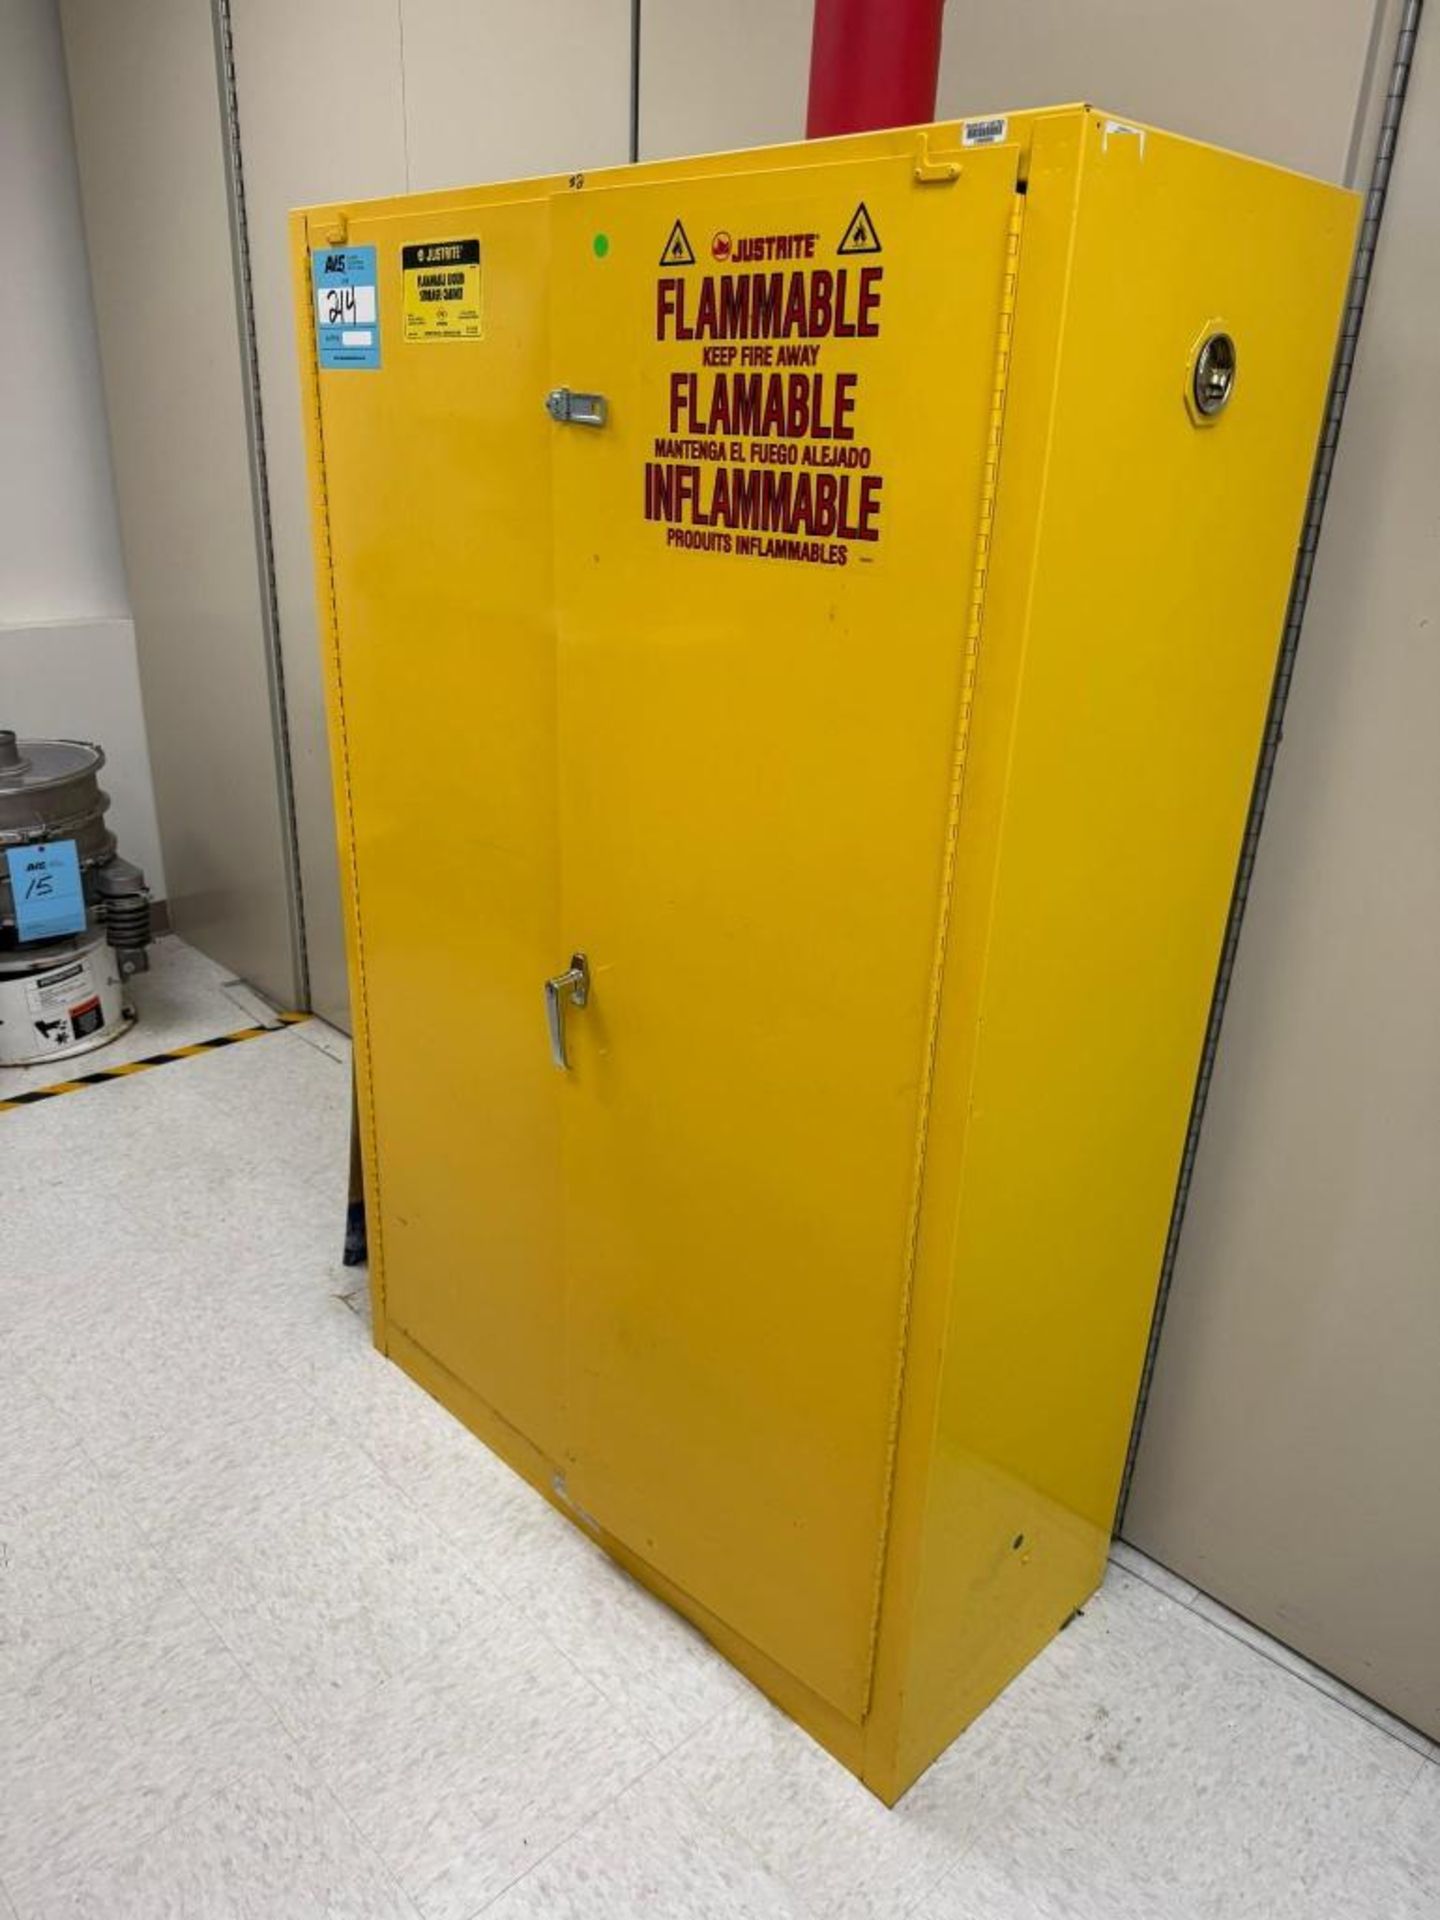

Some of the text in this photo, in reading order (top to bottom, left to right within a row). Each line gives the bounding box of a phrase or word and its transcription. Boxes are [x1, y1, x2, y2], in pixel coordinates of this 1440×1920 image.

[731, 233, 816, 263] JUSTRITE
[327, 285, 357, 327] 214
[656, 266, 884, 341] FLAMMABLE
[702, 344, 821, 368] KEEP FIRE AWAY
[669, 372, 858, 440] FLAMABLE
[654, 437, 871, 469] MANTENGA EL FUEGO ALEJADO
[644, 462, 883, 542] INFLAMMABLE
[667, 527, 848, 567] PRODUITS INFLAMMABLES
[25, 875, 54, 900] 15
